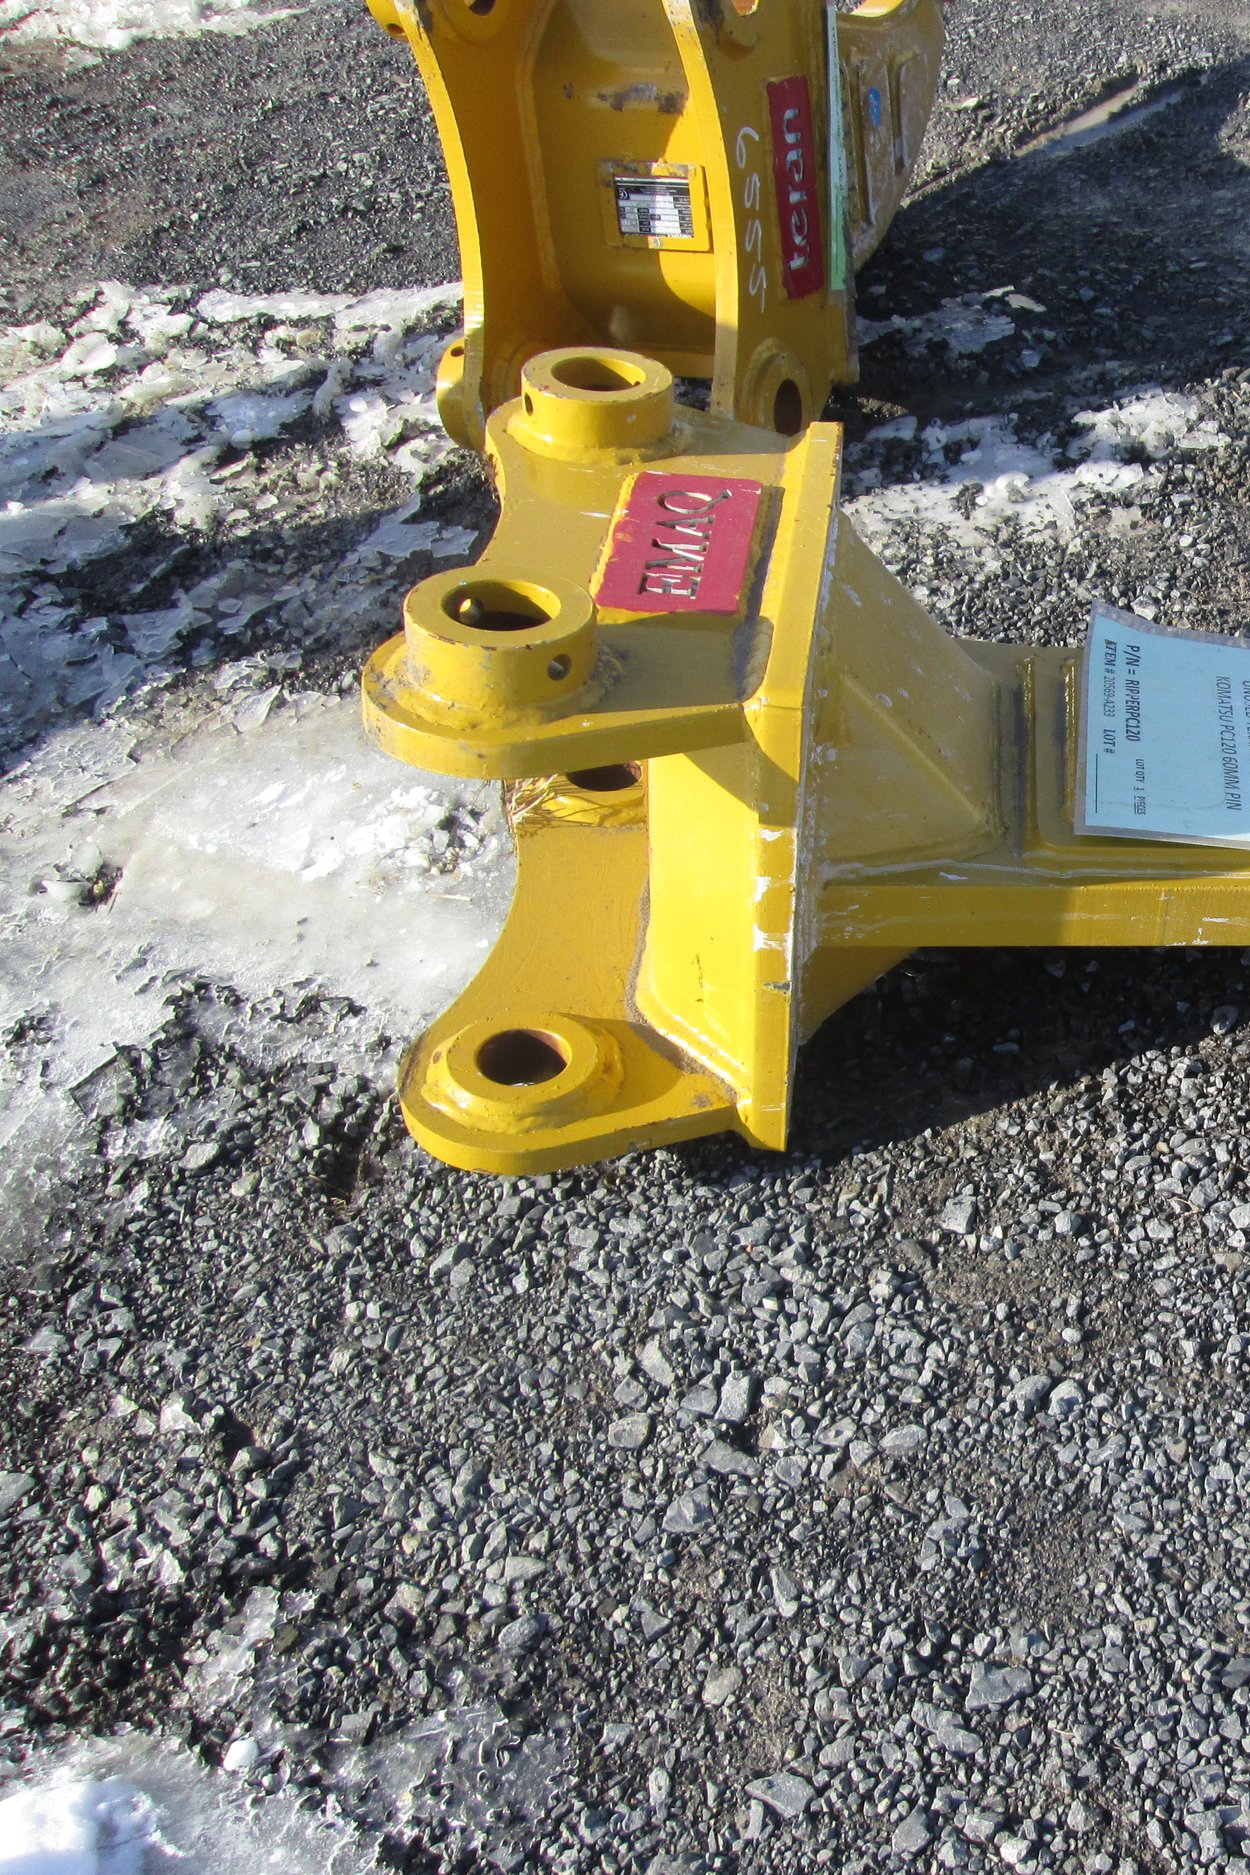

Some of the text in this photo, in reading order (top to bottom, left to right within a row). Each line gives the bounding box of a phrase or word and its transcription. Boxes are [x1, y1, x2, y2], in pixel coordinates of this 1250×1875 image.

[783, 107, 810, 270] teran
[637, 489, 733, 599] EMAQ
[1125, 644, 1141, 667] P/N
[1125, 679, 1142, 742] RIPPERPC120
[1103, 729, 1116, 747] LOT
[1216, 675, 1243, 811] KOMATSU PC120 60MM PIN
[1135, 758, 1145, 770] LOT
[1135, 770, 1145, 783] QTY
[1136, 795, 1146, 815] PIECES
